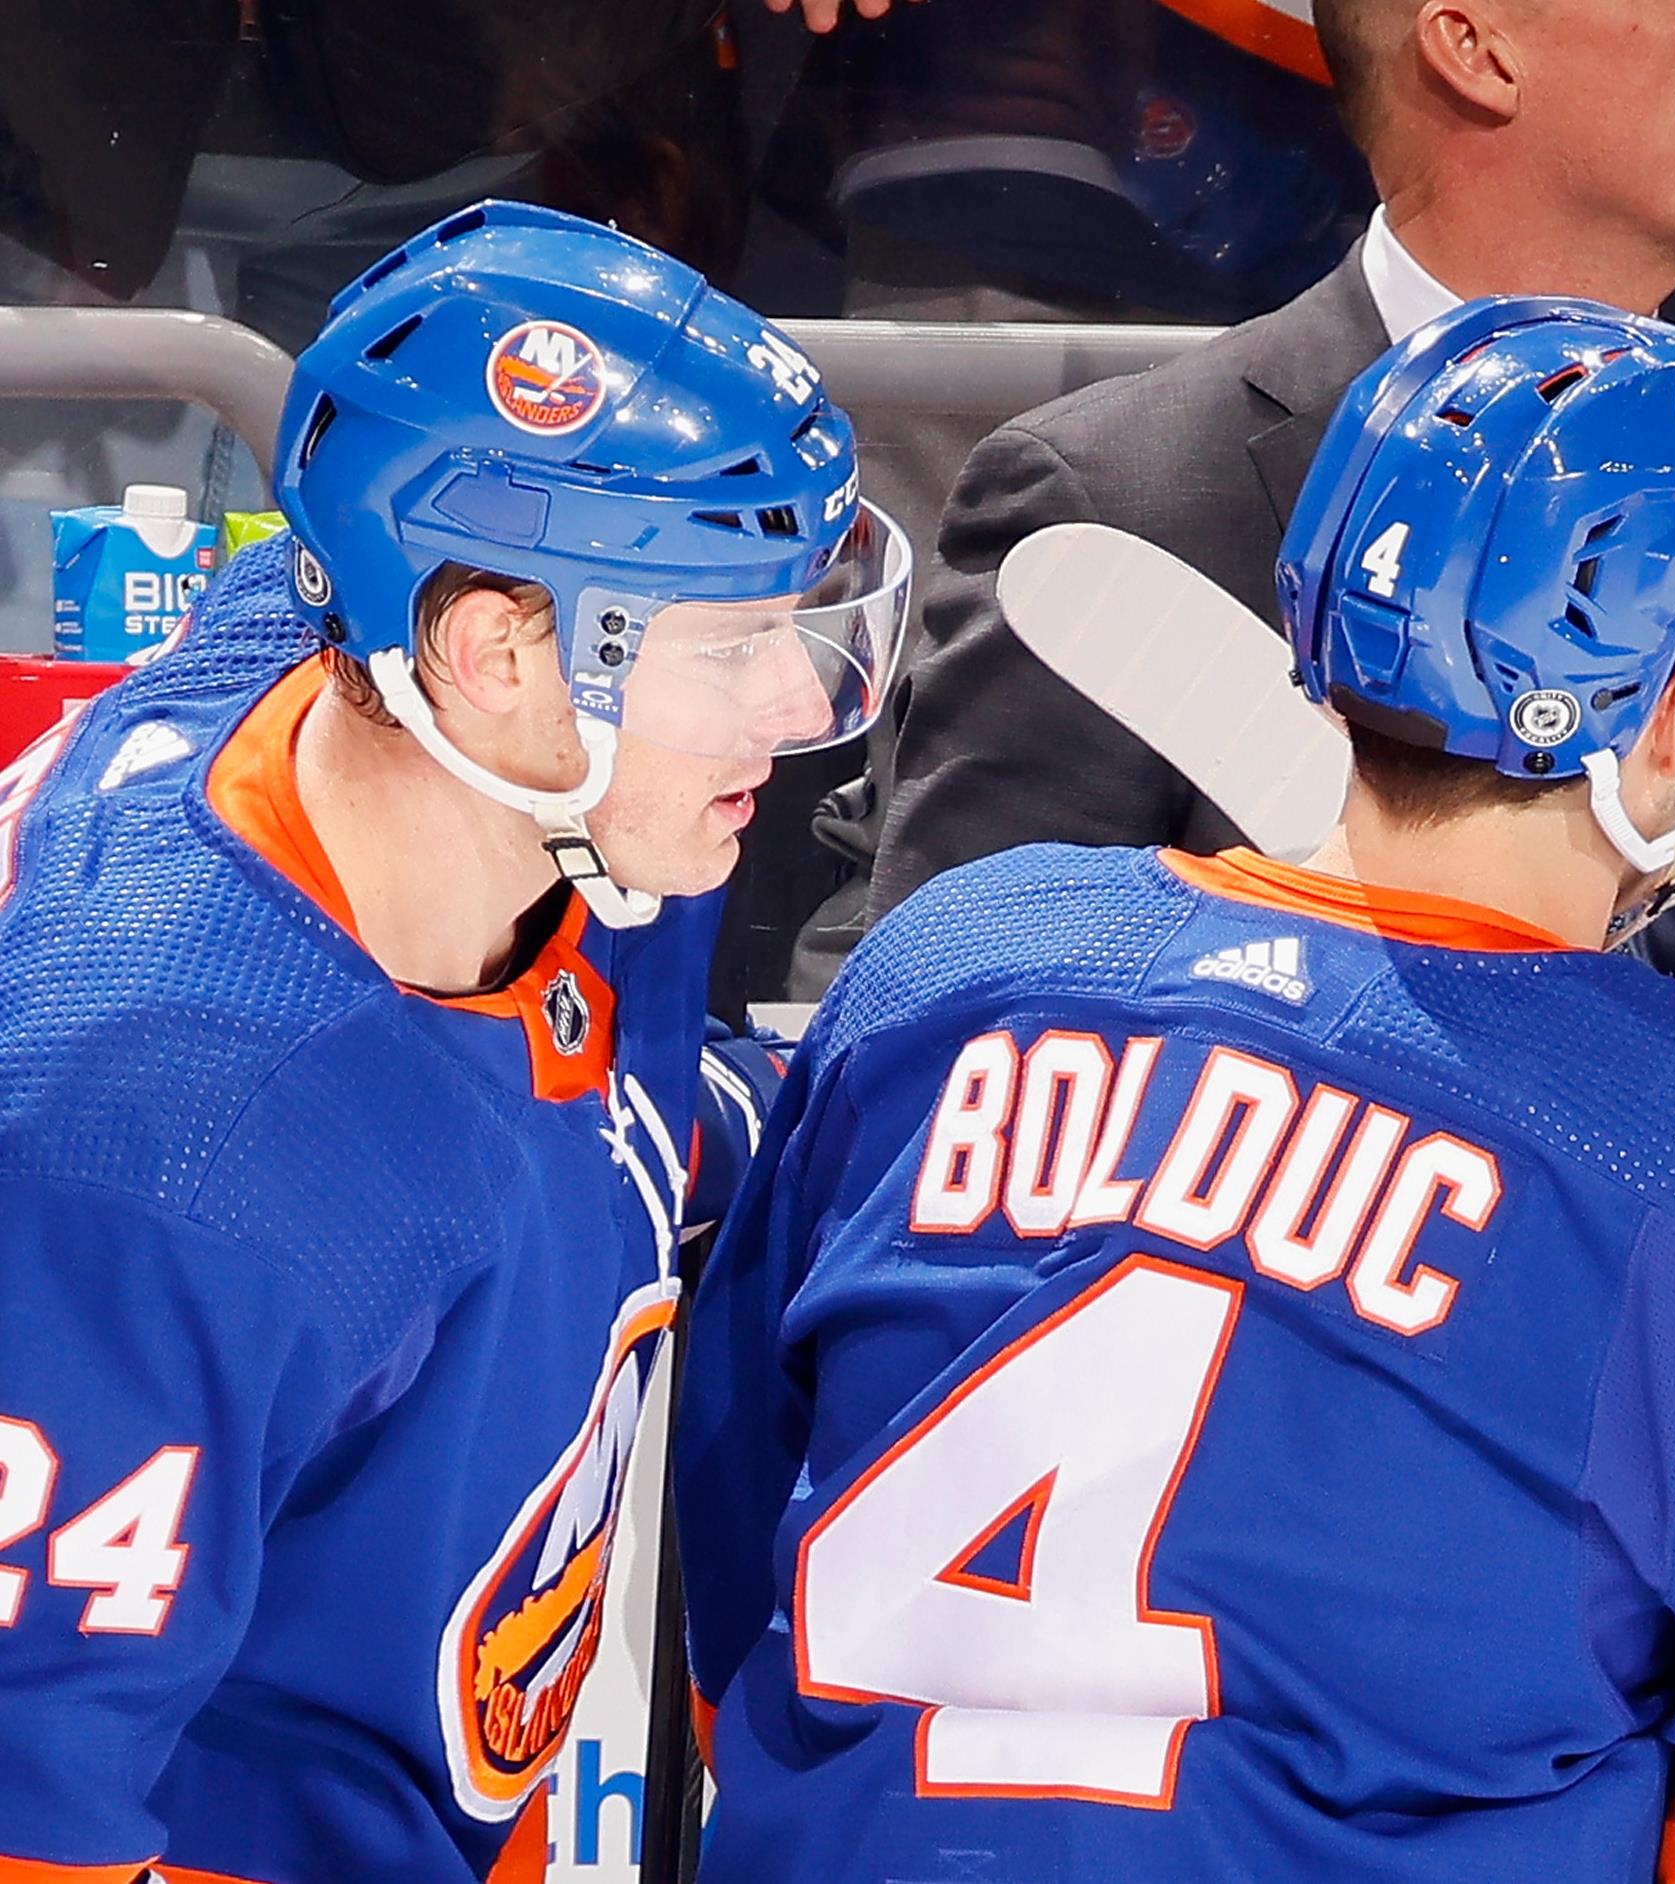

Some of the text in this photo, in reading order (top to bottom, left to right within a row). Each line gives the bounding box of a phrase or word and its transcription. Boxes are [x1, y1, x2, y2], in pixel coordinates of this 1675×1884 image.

[747, 330, 821, 405] 24
[1361, 522, 1409, 598] 4
[124, 615, 176, 634] STE
[1193, 953, 1306, 1000] adidas
[909, 1029, 1502, 1338] BOLDUC
[0, 1413, 202, 1638] 24
[793, 1252, 1246, 1811] 4
